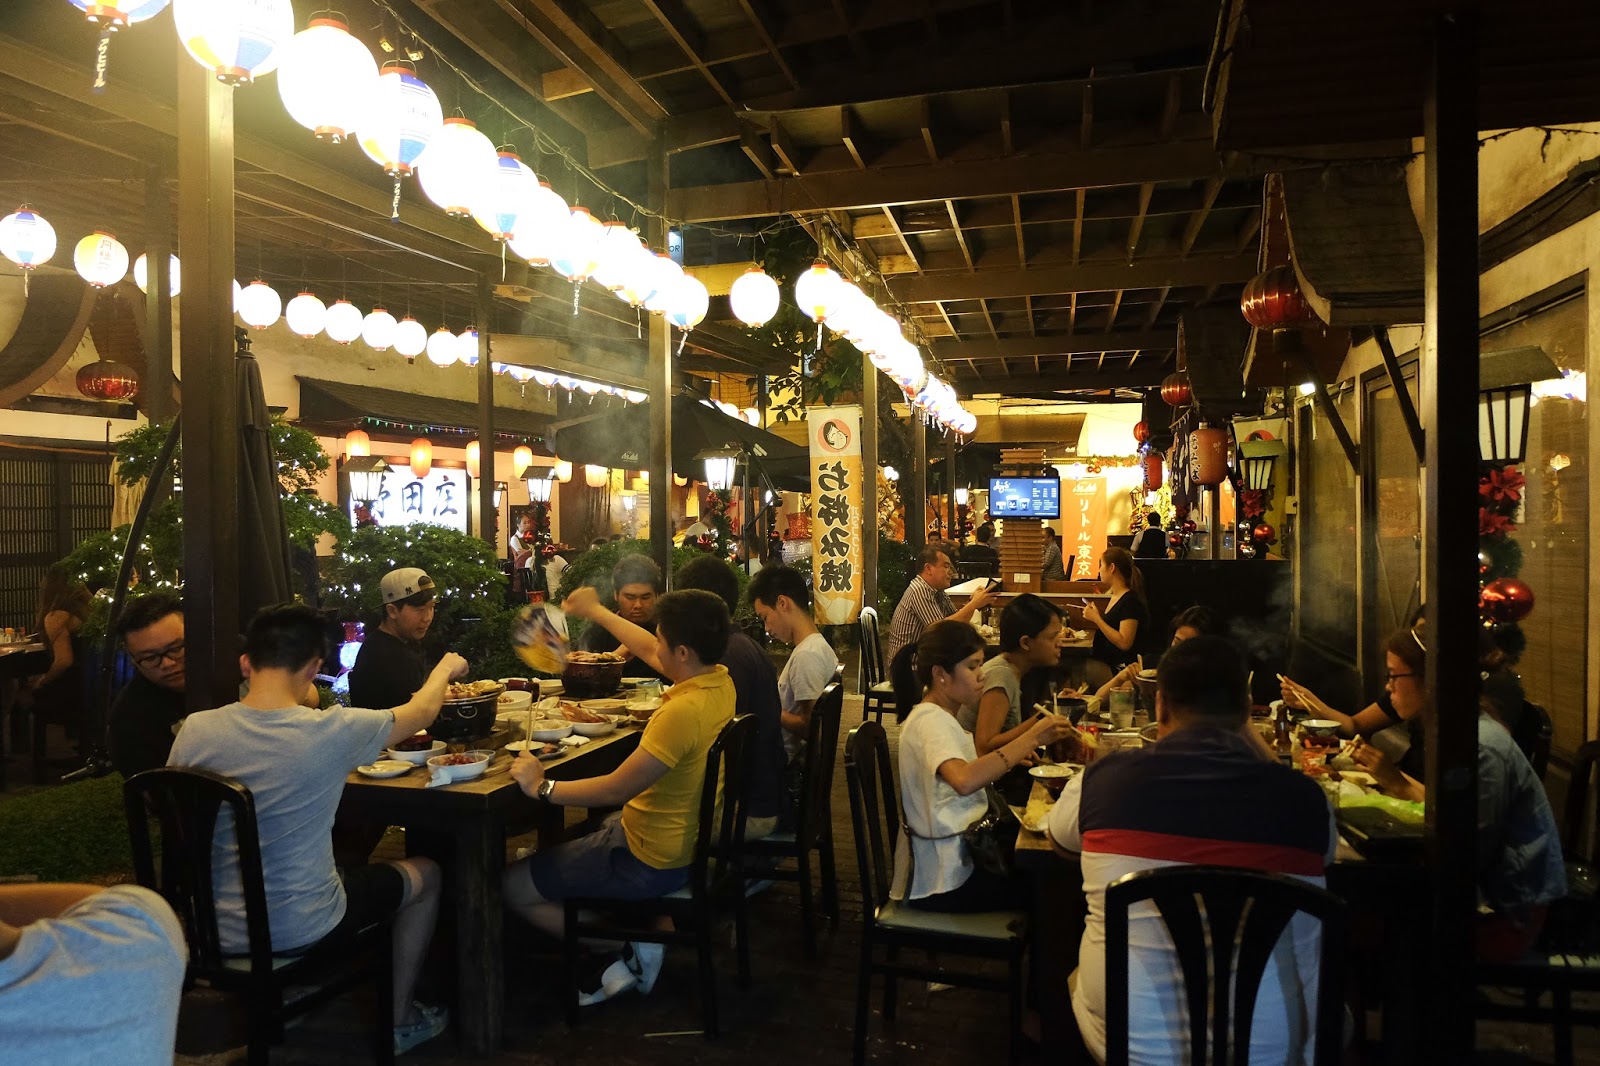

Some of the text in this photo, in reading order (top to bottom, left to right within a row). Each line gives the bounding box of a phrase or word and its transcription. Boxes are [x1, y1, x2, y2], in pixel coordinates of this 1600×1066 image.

[1077, 498, 1093, 576] リトル東京
